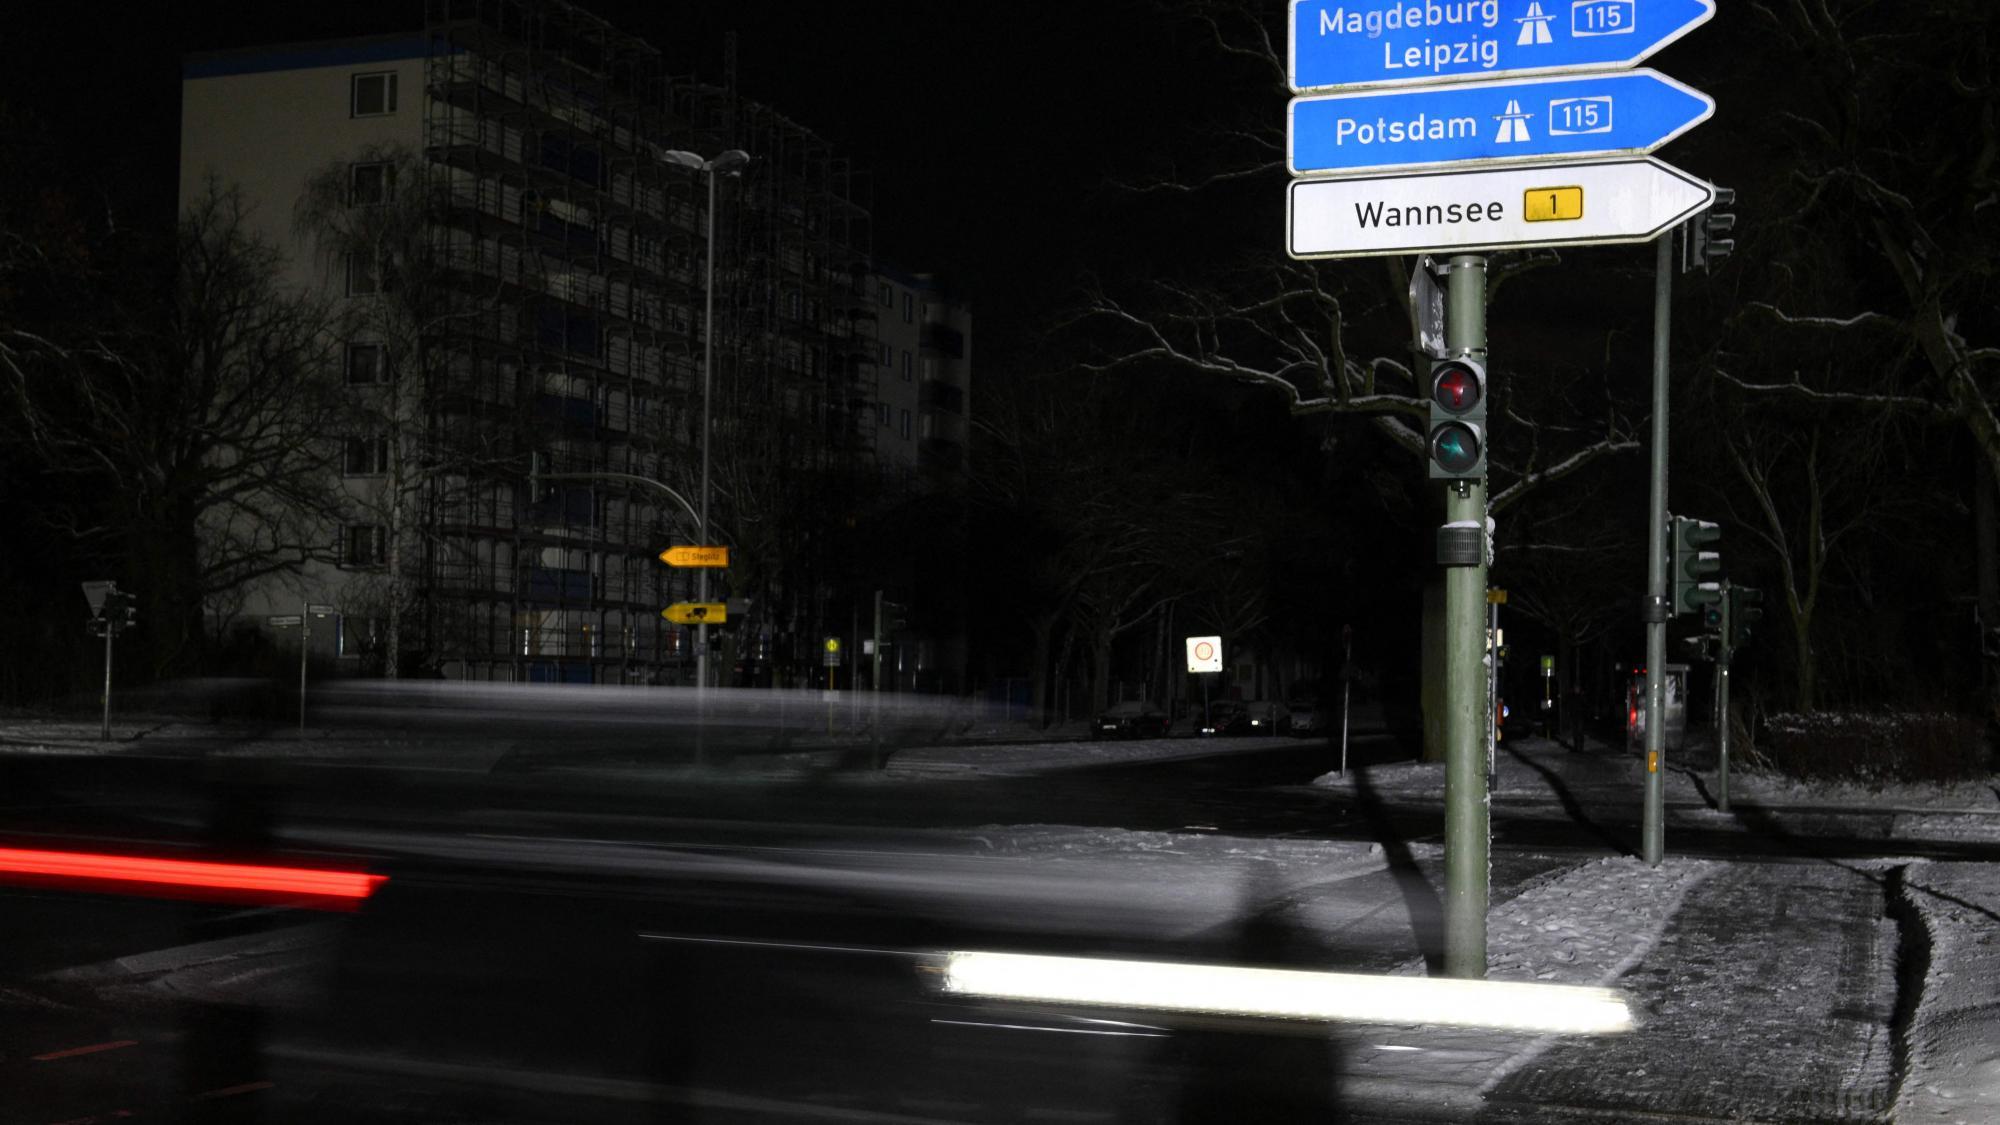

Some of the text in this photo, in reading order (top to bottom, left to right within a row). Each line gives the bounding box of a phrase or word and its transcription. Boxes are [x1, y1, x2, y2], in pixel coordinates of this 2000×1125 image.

[1319, 0, 1621, 38] Magdeburg 115
[1384, 34, 1498, 72] Leipzig
[1336, 104, 1598, 146] Potsdam 115
[1355, 194, 1558, 228] Wannsee 1
